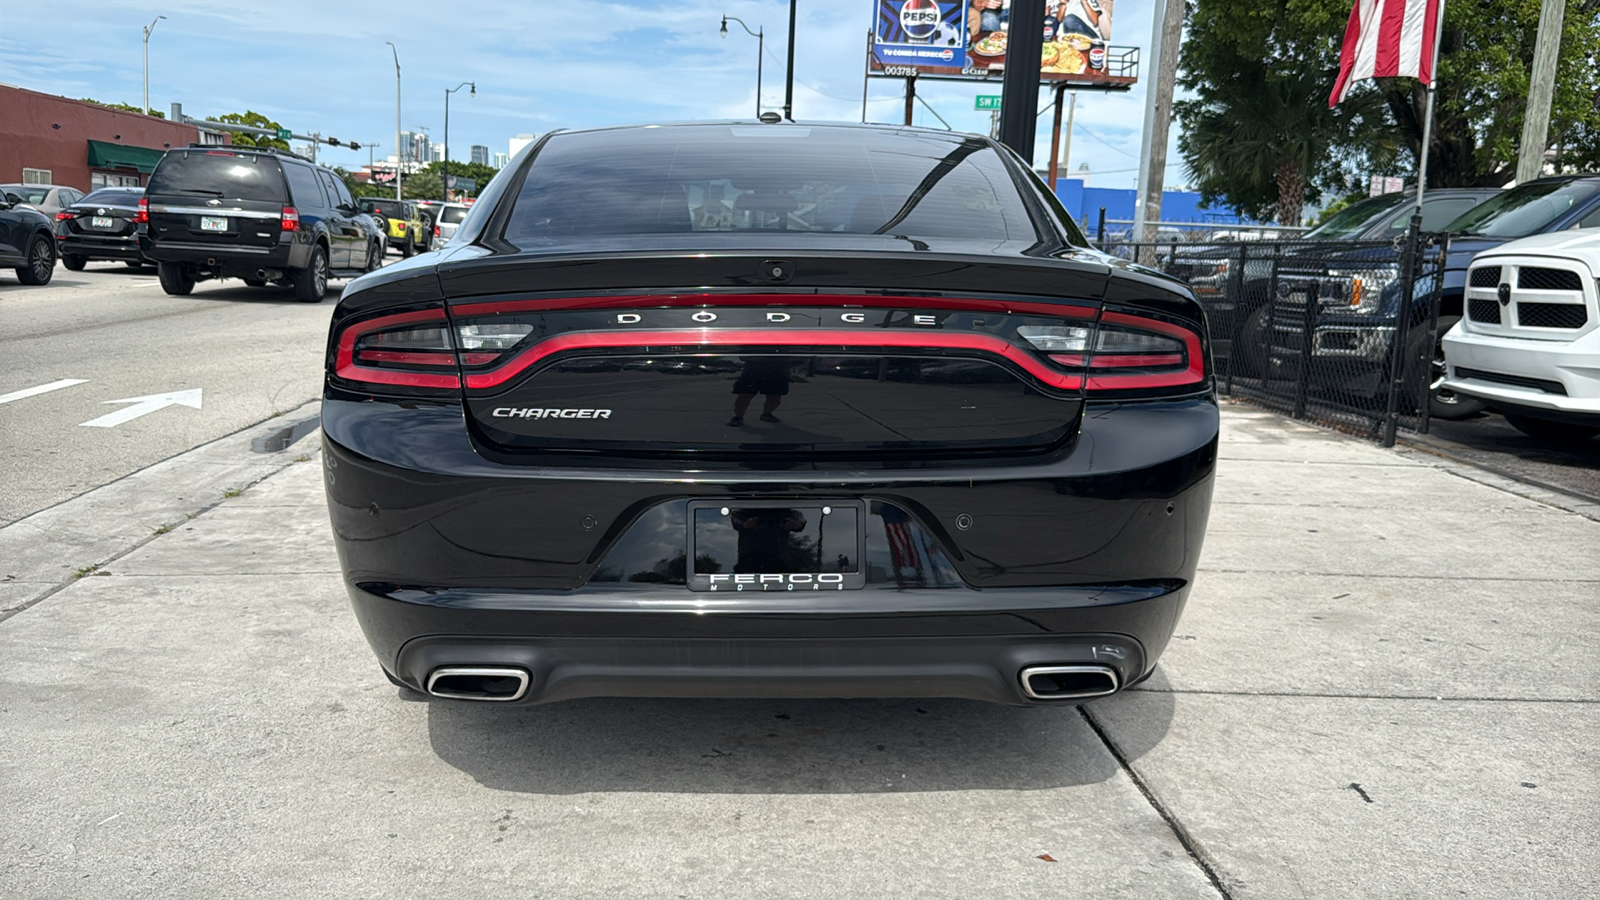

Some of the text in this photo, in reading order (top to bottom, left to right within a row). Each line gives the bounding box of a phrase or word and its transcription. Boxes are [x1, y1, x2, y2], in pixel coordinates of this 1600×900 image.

[903, 12, 938, 22] PEPSI
[885, 66, 918, 77] 003785
[979, 97, 991, 107] SW
[617, 311, 936, 325] DODGE
[492, 407, 613, 420] CHARGER
[709, 573, 844, 584] FERCO
[710, 583, 844, 591] MOTORS
